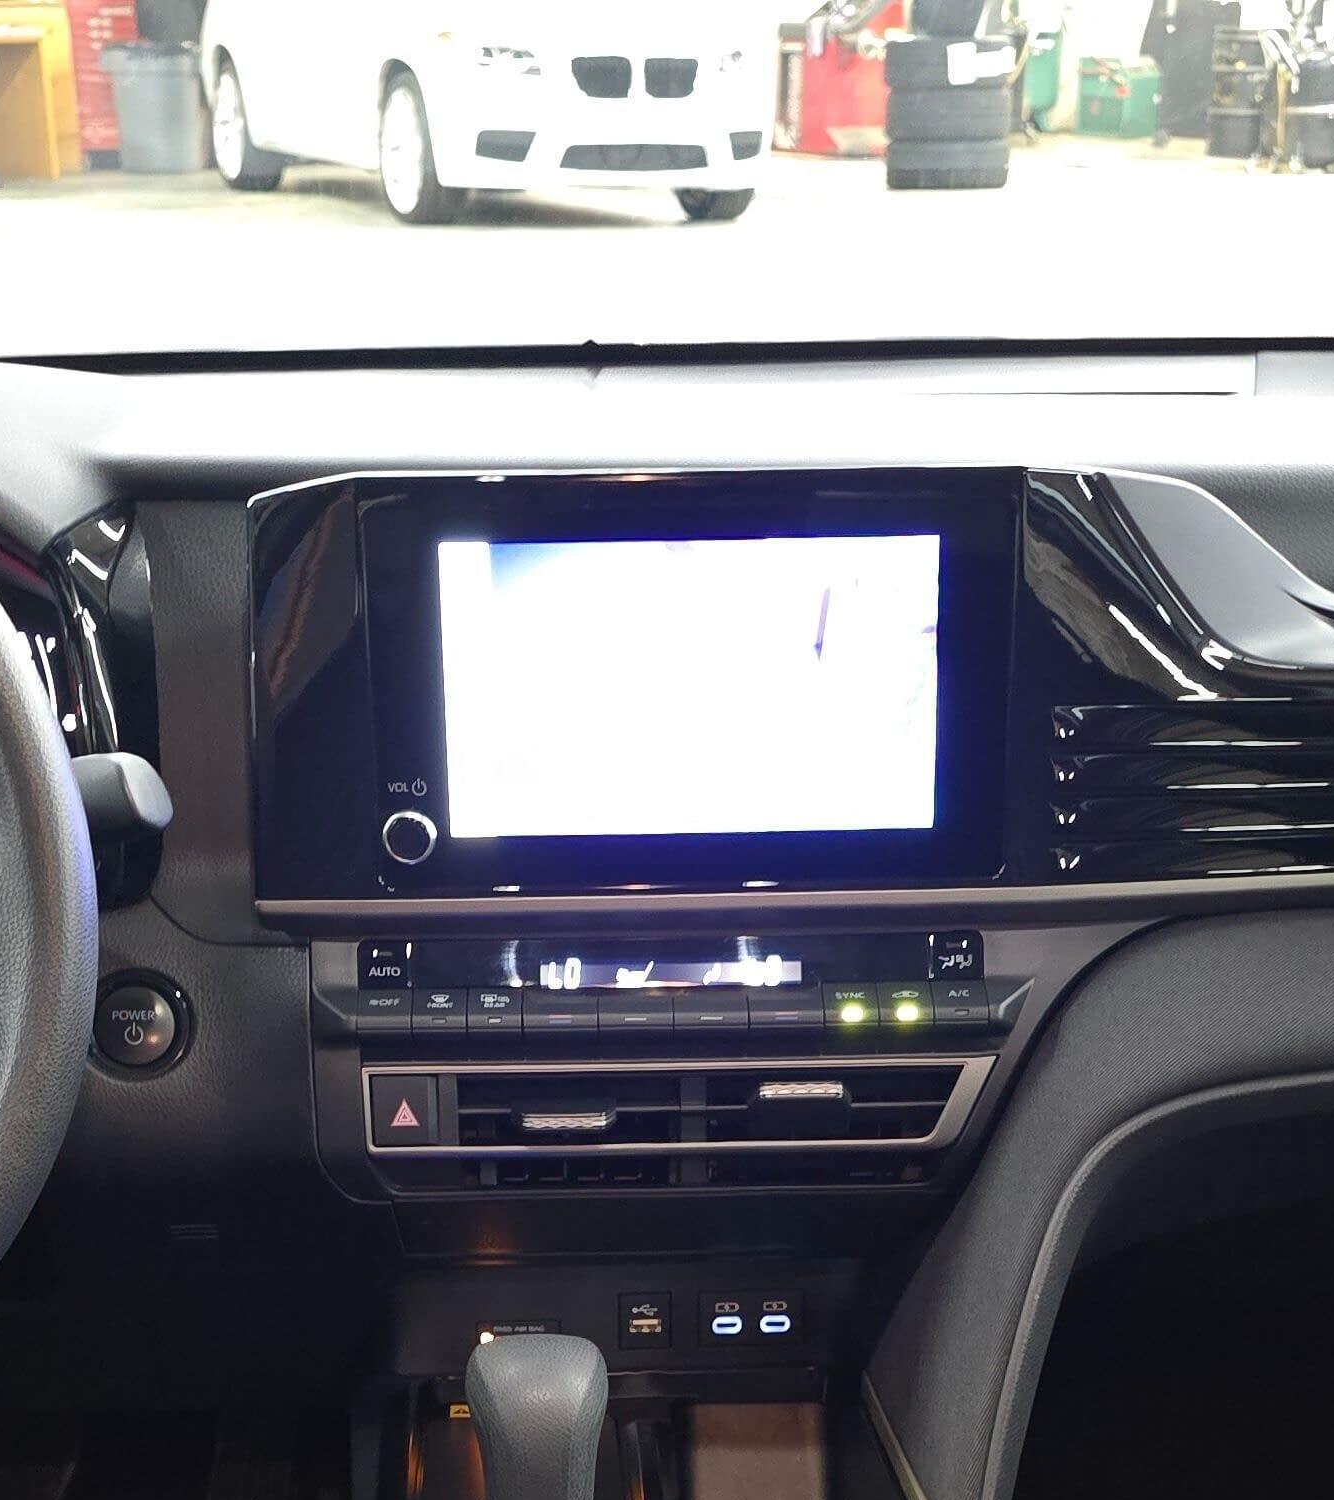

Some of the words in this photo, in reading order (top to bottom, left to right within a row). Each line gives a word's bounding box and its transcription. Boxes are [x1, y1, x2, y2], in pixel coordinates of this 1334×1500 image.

[387, 782, 409, 793] VOL
[368, 966, 401, 977] AUTO
[834, 991, 866, 1000] SYNC
[948, 989, 970, 998] A/C
[380, 998, 401, 1007] OFF
[426, 1001, 454, 1009] FRONT
[111, 1010, 156, 1021] POWER
